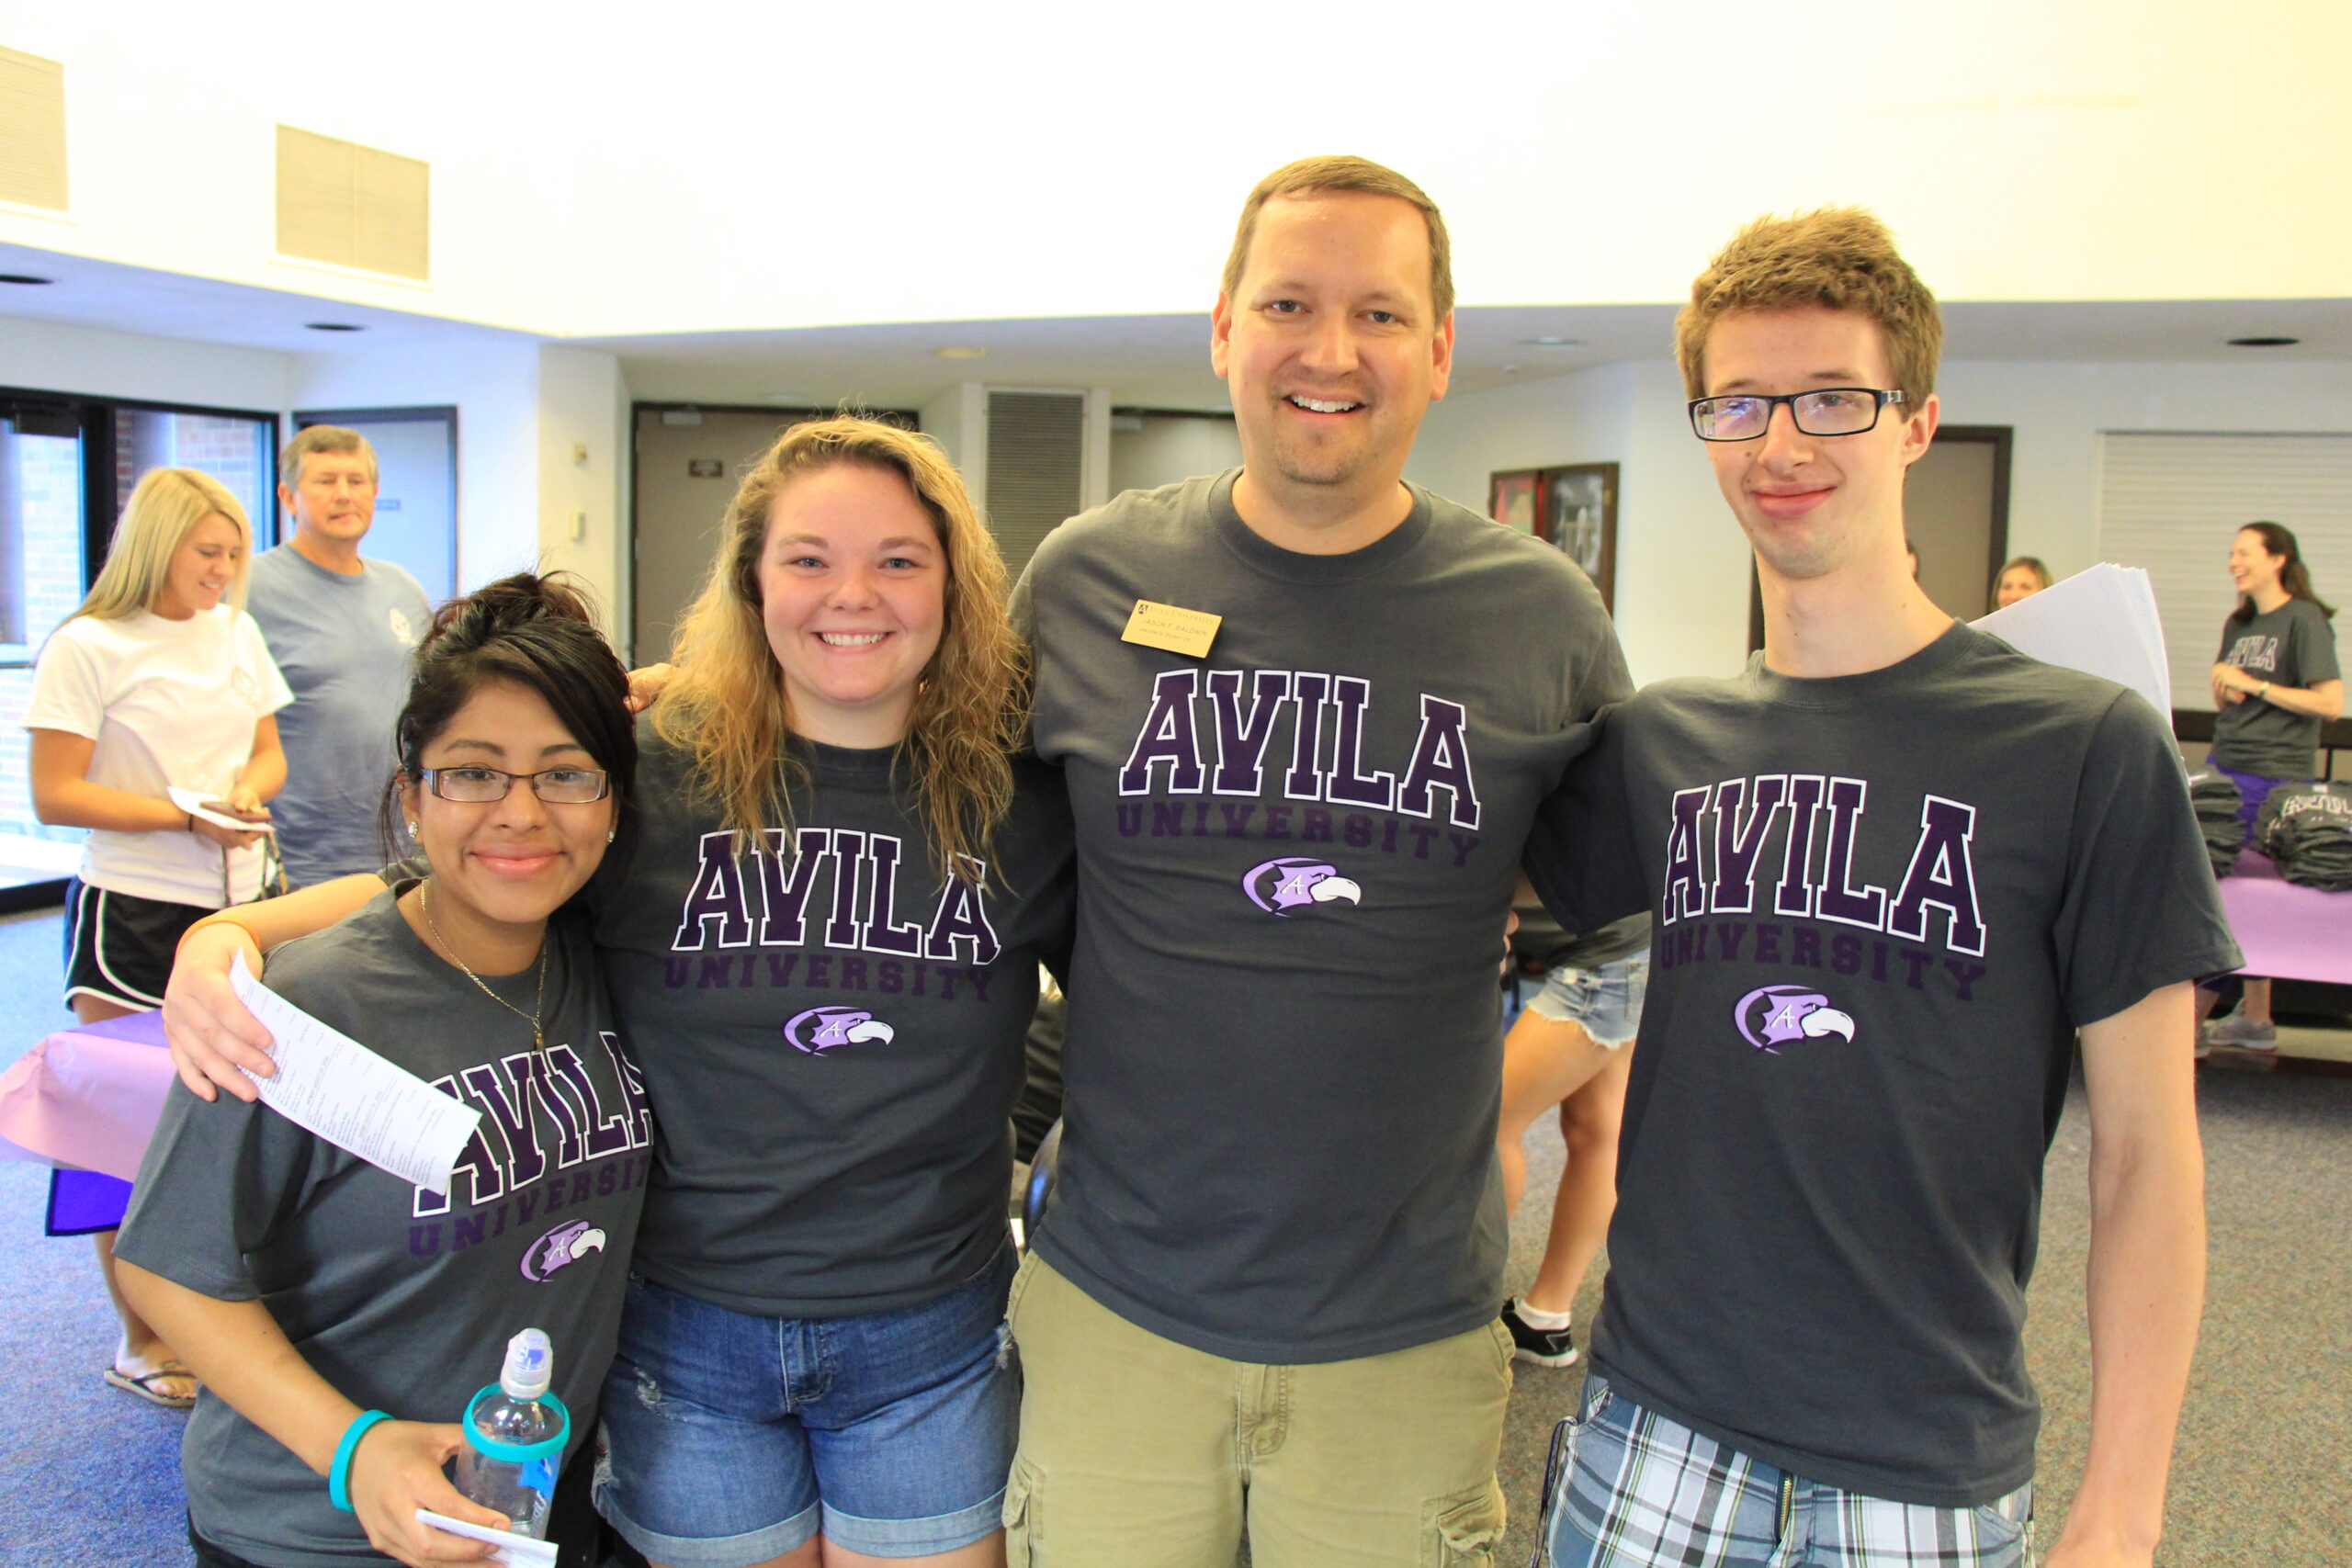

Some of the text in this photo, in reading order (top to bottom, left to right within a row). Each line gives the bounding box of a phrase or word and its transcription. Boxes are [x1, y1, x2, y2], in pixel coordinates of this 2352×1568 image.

[1171, 610, 1214, 625] UNIVERSITY
[1119, 668, 1480, 830] AVILA
[1116, 800, 1480, 867] UNIVERSITY
[1663, 774, 1986, 957] AVILA
[671, 828, 1001, 965] AVILA
[664, 953, 995, 1002] UNIVERSITY
[1660, 922, 1986, 1001] UNIVERSITY
